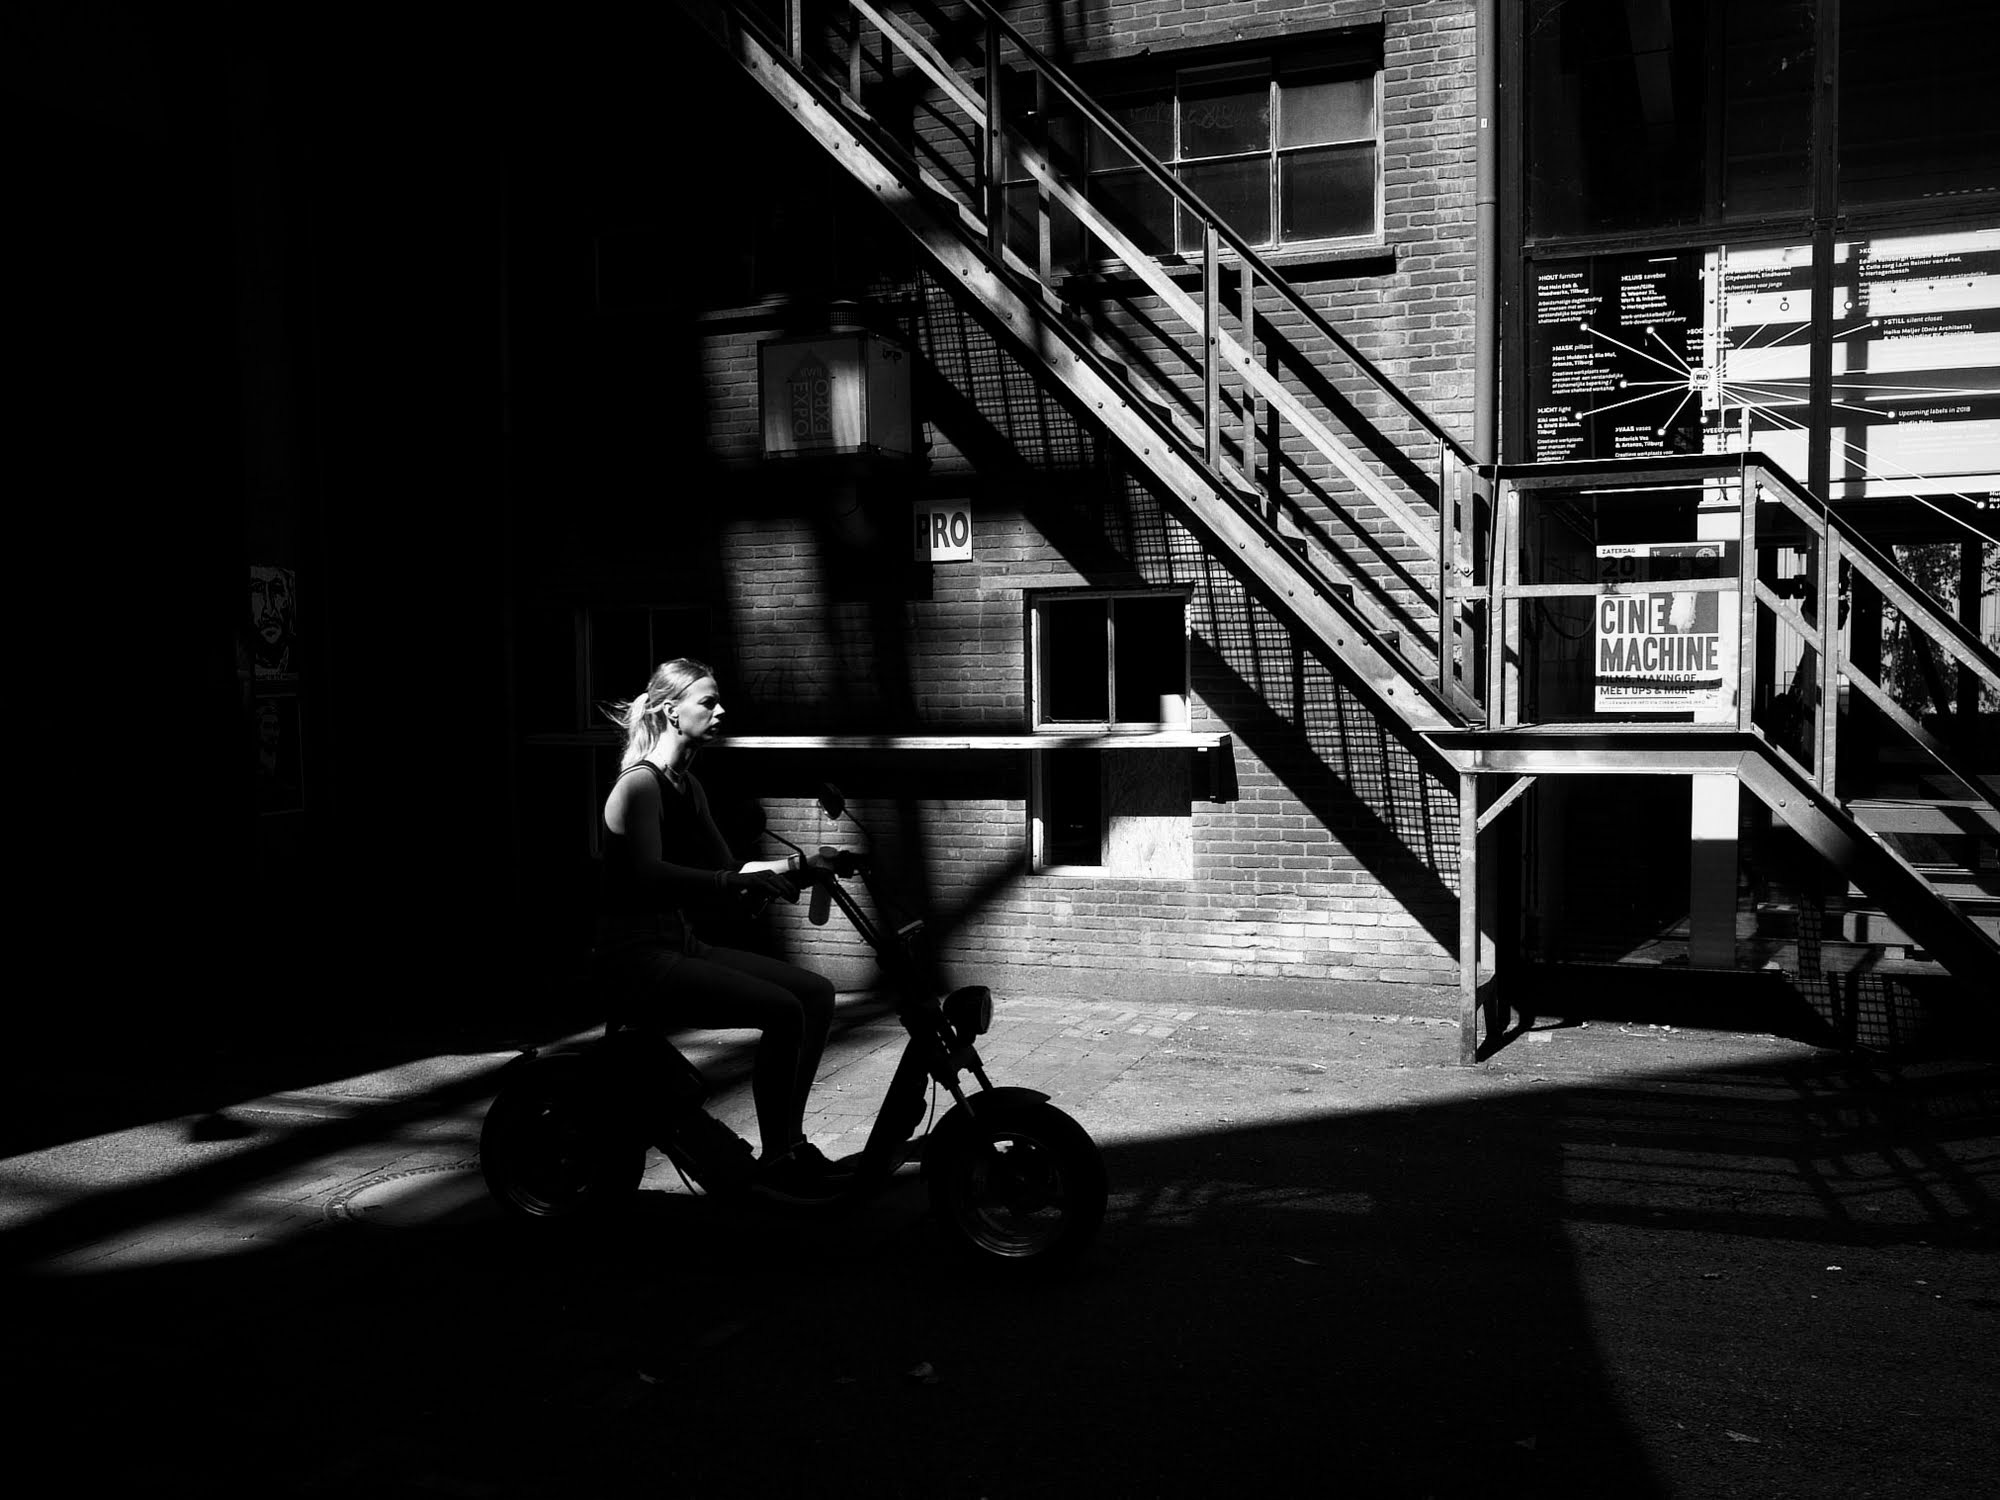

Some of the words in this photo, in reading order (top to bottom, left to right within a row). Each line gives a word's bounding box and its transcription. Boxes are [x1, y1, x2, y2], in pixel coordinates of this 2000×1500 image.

[793, 383, 808, 436] EXPO
[815, 380, 828, 433] EXPO
[1899, 408, 1929, 417] Upcoming
[916, 511, 969, 549] PRO
[1602, 556, 1635, 576] 20
[1601, 598, 1665, 634] CINE
[1600, 637, 1719, 671] MACHINE
[1600, 675, 1635, 683] FILMS,
[1636, 674, 1681, 683] MAKING
[1600, 687, 1630, 695] MEET
